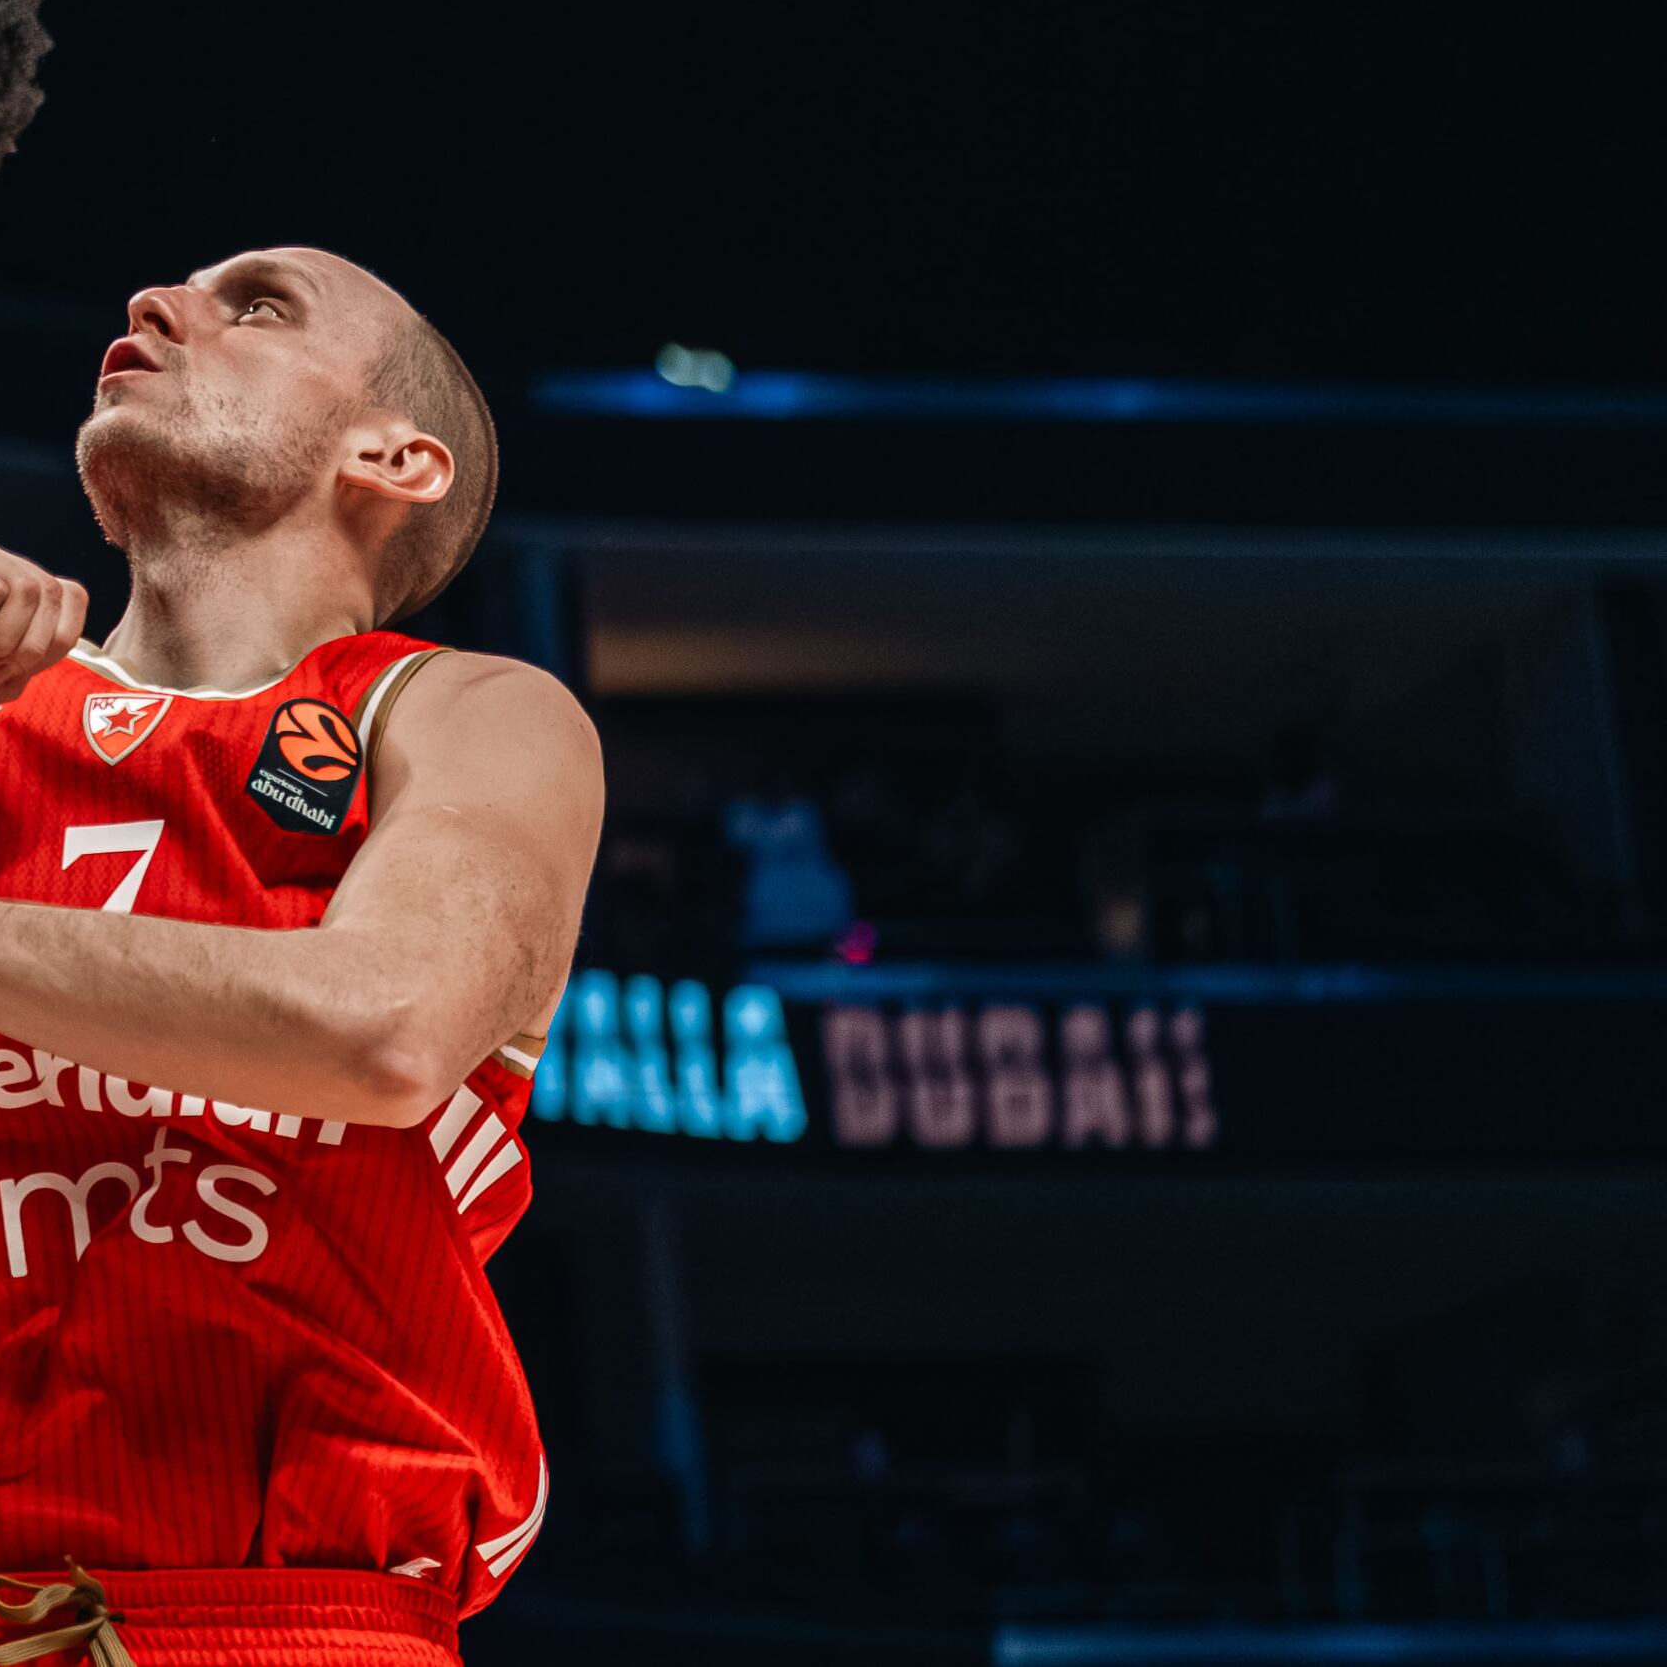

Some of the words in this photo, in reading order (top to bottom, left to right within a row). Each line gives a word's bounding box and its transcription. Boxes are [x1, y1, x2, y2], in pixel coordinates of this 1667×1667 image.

[251, 778, 286, 803] abu
[285, 795, 337, 830] dhabi
[62, 819, 165, 915] 7
[824, 1004, 1213, 1148] DUBAI!
[0, 1126, 278, 1278] mts
